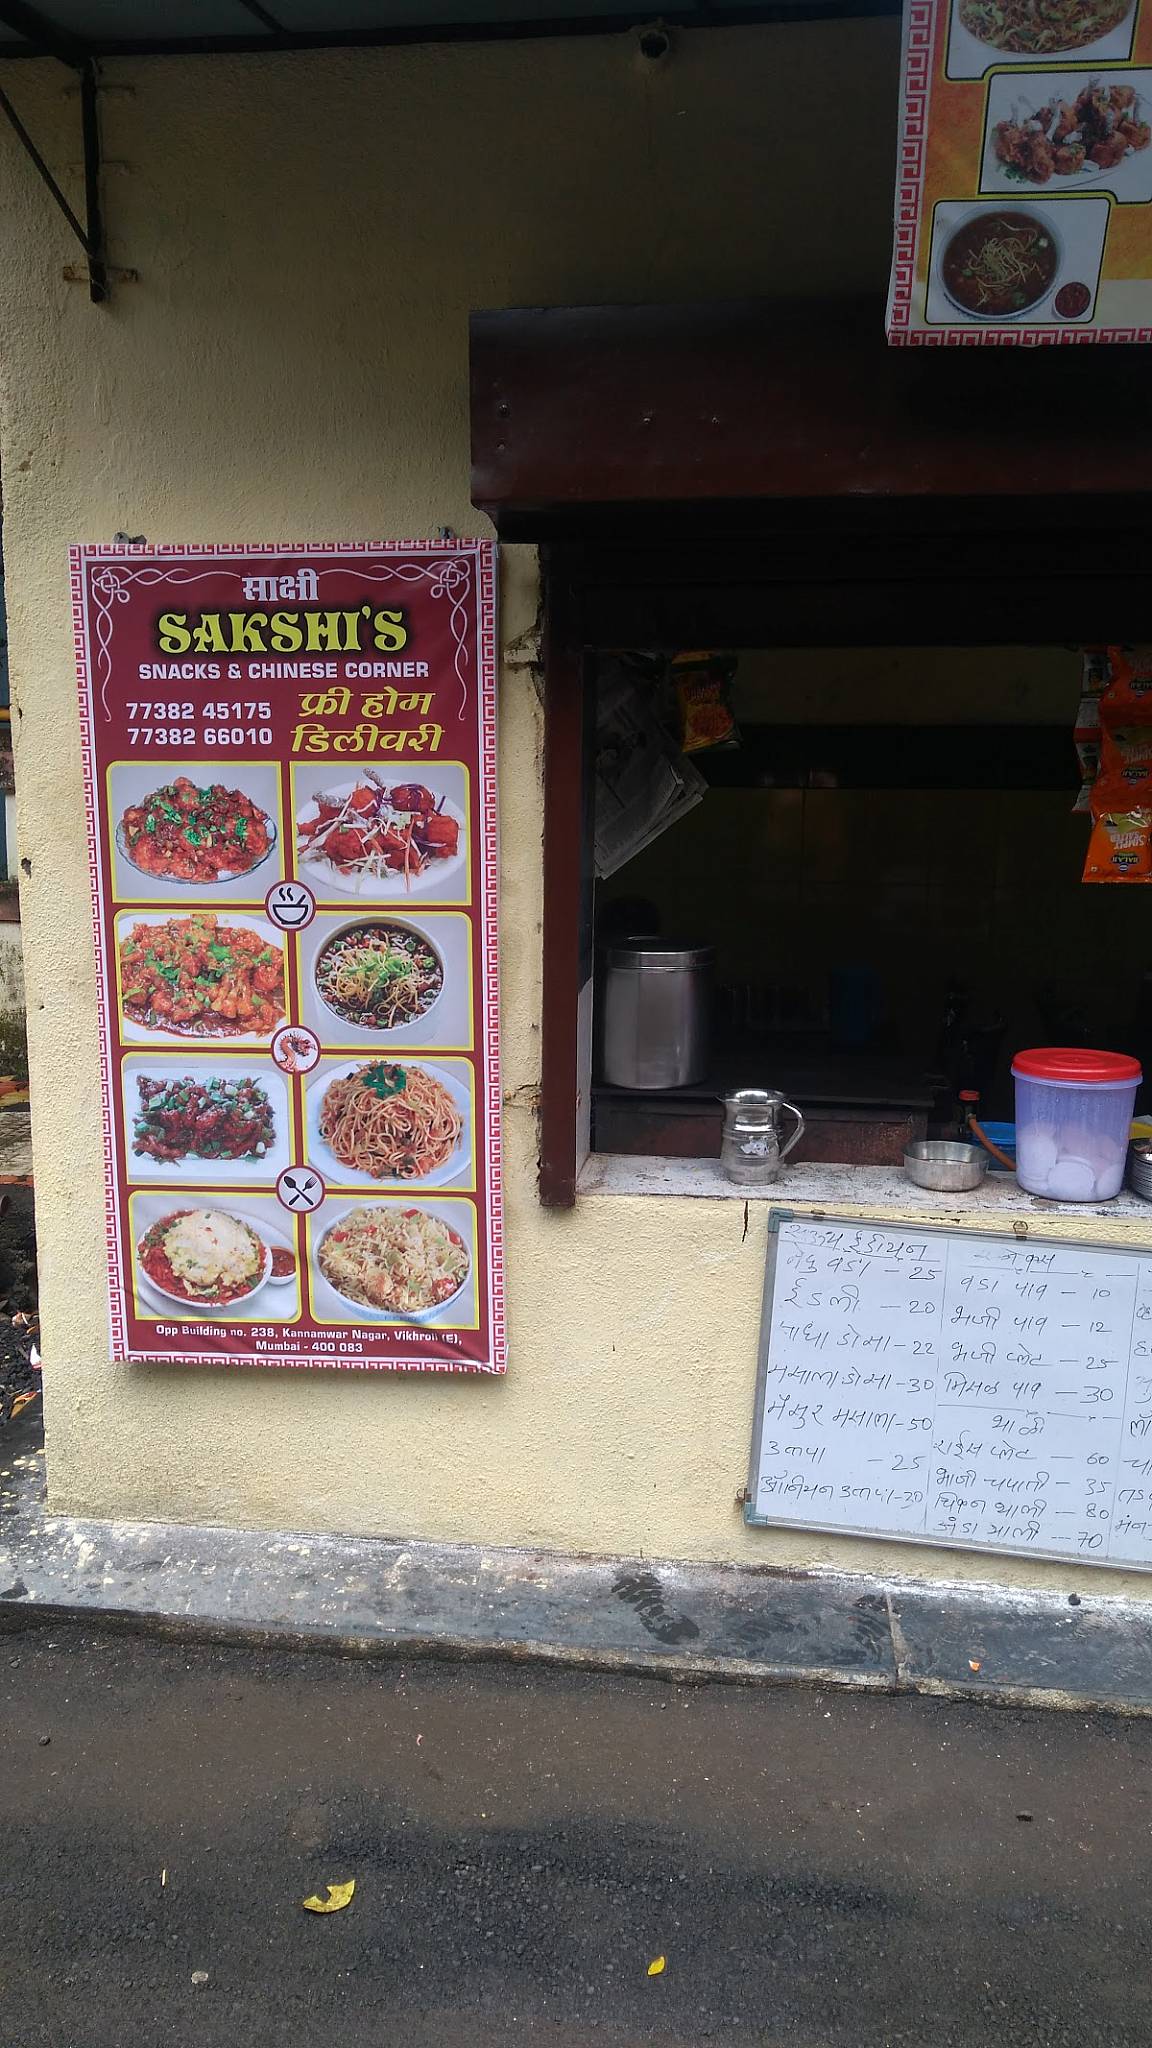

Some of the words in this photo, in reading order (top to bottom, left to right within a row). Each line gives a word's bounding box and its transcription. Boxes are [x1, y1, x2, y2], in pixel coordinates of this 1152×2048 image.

[242, 568, 319, 602] साक्षी
[157, 605, 408, 654] SAKSHI'S
[138, 663, 221, 680] SNACKS
[227, 663, 242, 679] &
[247, 662, 338, 679] CHINESE
[344, 661, 429, 678] CORNER
[126, 702, 195, 720] 77382
[202, 702, 272, 720] 45175
[298, 686, 354, 718] फ्री
[360, 686, 436, 718] होम
[127, 728, 196, 746] 77382
[203, 727, 273, 745] 66010
[290, 723, 445, 753] डिलीवरी
[909, 1267, 942, 1280] 25
[1015, 1282, 1047, 1300] पाव
[1092, 1288, 1111, 1299] 10
[909, 1301, 936, 1314] 20
[155, 1325, 179, 1338] Opp
[181, 1324, 228, 1339] Building
[230, 1329, 247, 1338] no.
[250, 1327, 278, 1339] 238,
[282, 1327, 348, 1340] Kannamwar
[351, 1329, 390, 1342] Nagar,
[1014, 1316, 1048, 1335] पाव
[1089, 1321, 1112, 1333] 12
[256, 1340, 301, 1352] Mumbai
[311, 1341, 335, 1353] 400
[339, 1342, 363, 1353] 083
[912, 1340, 935, 1355] 22
[1086, 1356, 1119, 1369] 25
[907, 1378, 934, 1393] 30
[1013, 1382, 1042, 1399] पाव
[1080, 1385, 1113, 1403] 30
[907, 1417, 933, 1431] 50
[891, 1454, 926, 1470] 25
[1086, 1452, 1110, 1465] 60
[1085, 1478, 1112, 1496] 35
[1086, 1502, 1110, 1519] 80
[1078, 1532, 1103, 1548] 70
